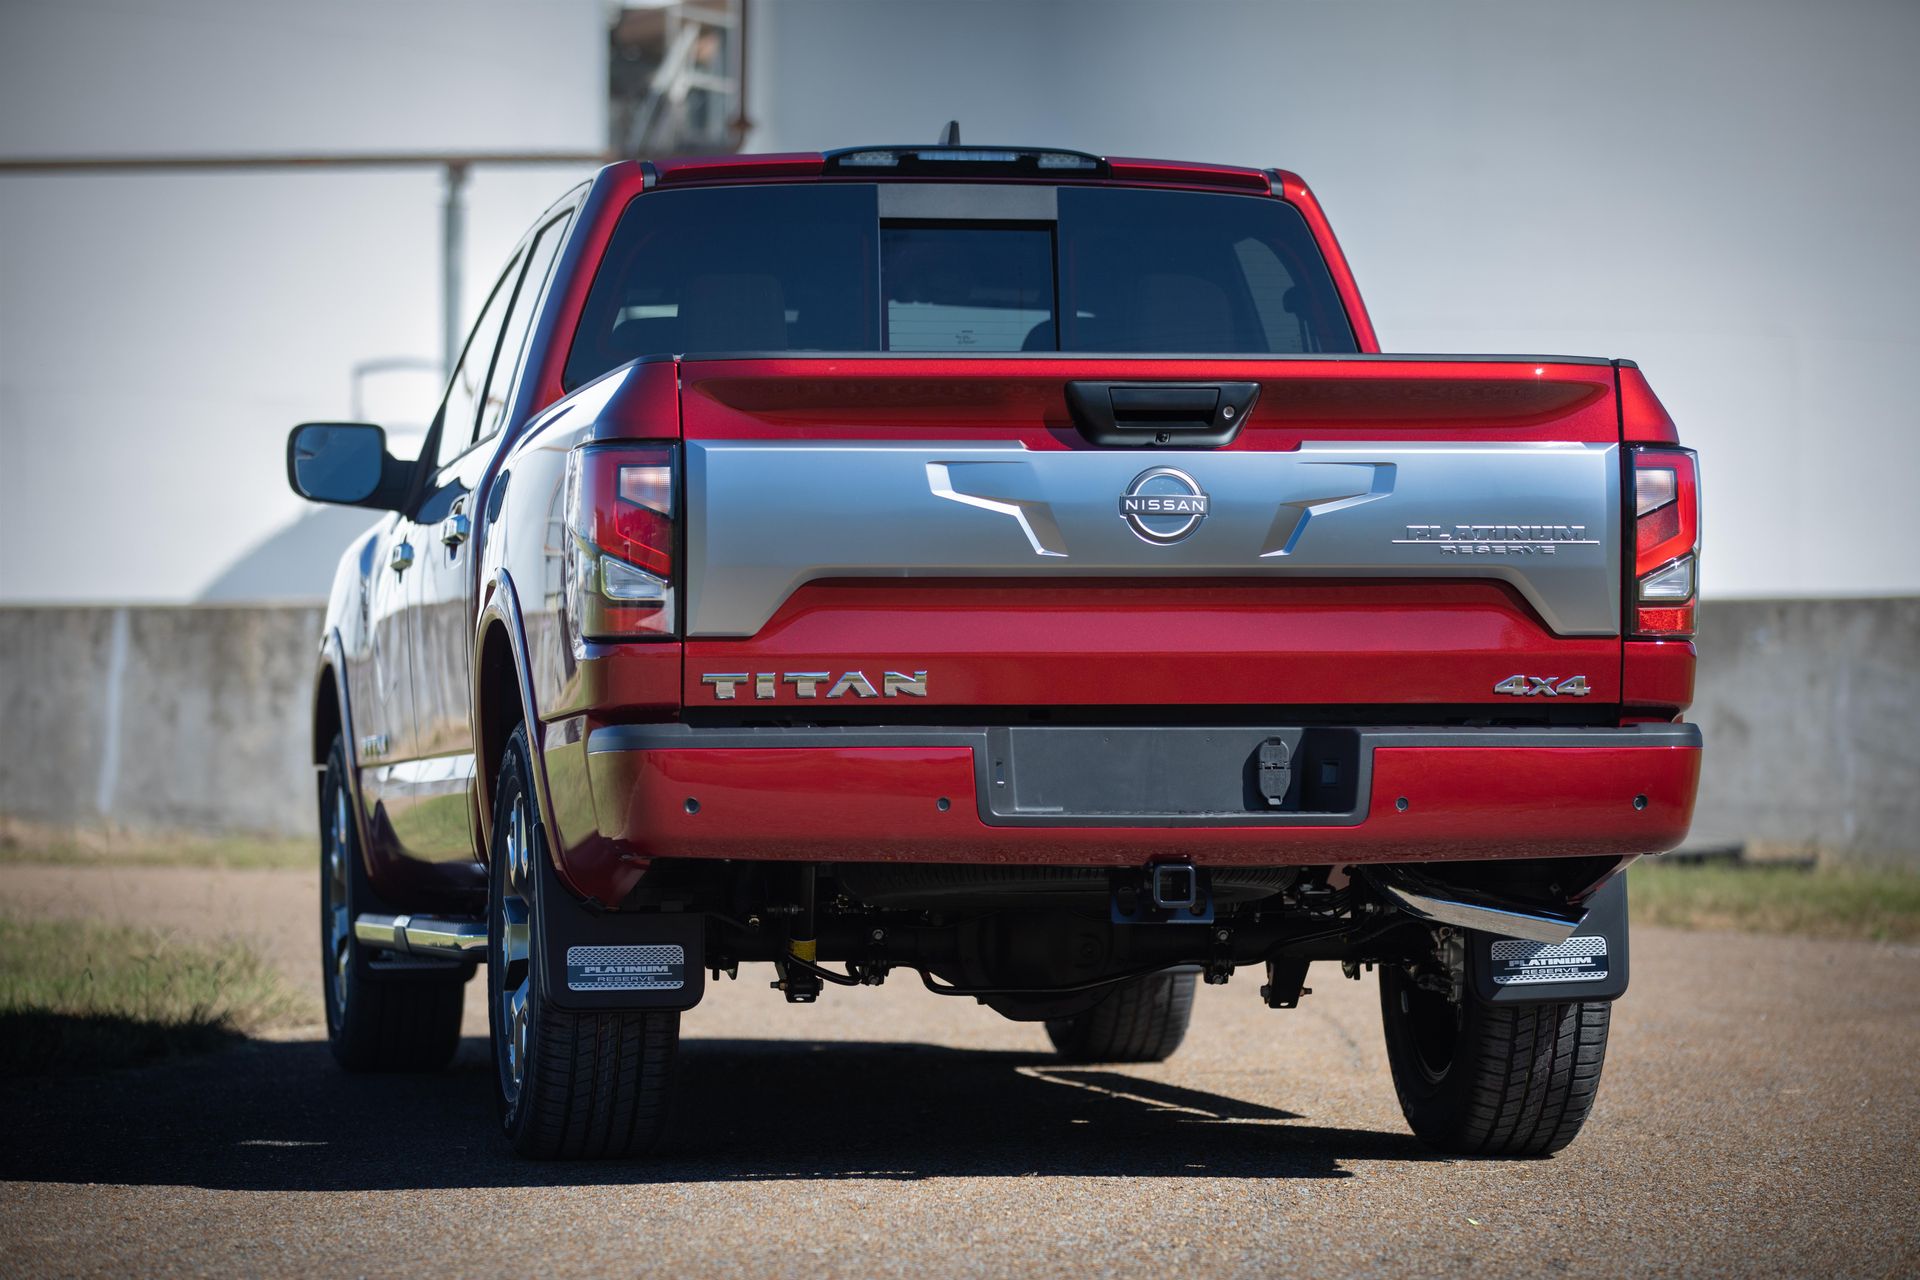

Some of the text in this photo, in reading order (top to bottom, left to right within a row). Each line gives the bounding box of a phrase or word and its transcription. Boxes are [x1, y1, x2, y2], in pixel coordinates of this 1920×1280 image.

[1125, 499, 1204, 511] NISSAN
[1406, 525, 1586, 541] PLATINUM
[1440, 545, 1556, 555] RESERVE
[702, 671, 928, 699] TITAN
[1508, 956, 1592, 967] PLATINUM
[584, 965, 669, 973] PLATINUM
[1521, 967, 1579, 975] RESERVE
